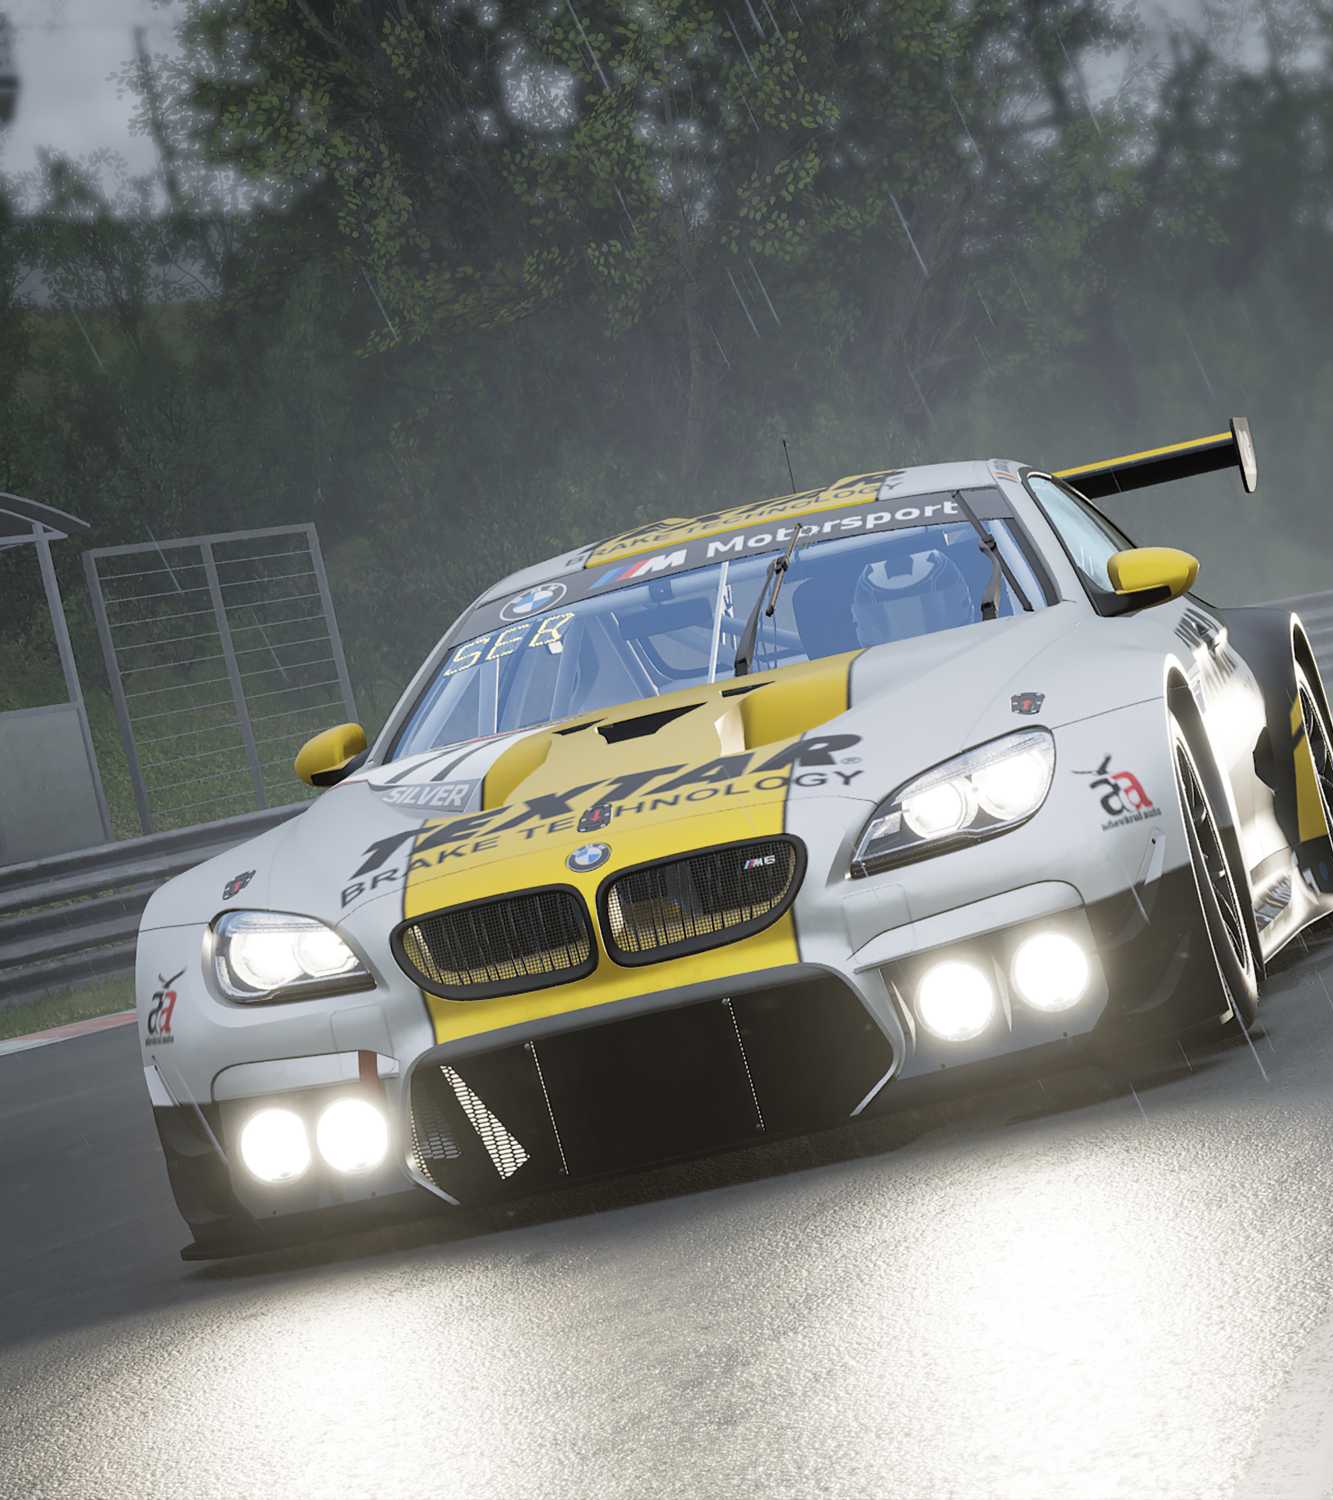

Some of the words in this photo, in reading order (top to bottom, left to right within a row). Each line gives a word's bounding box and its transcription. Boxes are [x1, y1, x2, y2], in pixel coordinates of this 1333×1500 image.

[706, 500, 959, 558] Motorsport
[340, 837, 497, 909] BRAKE
[523, 769, 864, 841] TEHNOLOGY
[349, 733, 862, 880] TEXTAR
[381, 783, 470, 806] SILVER
